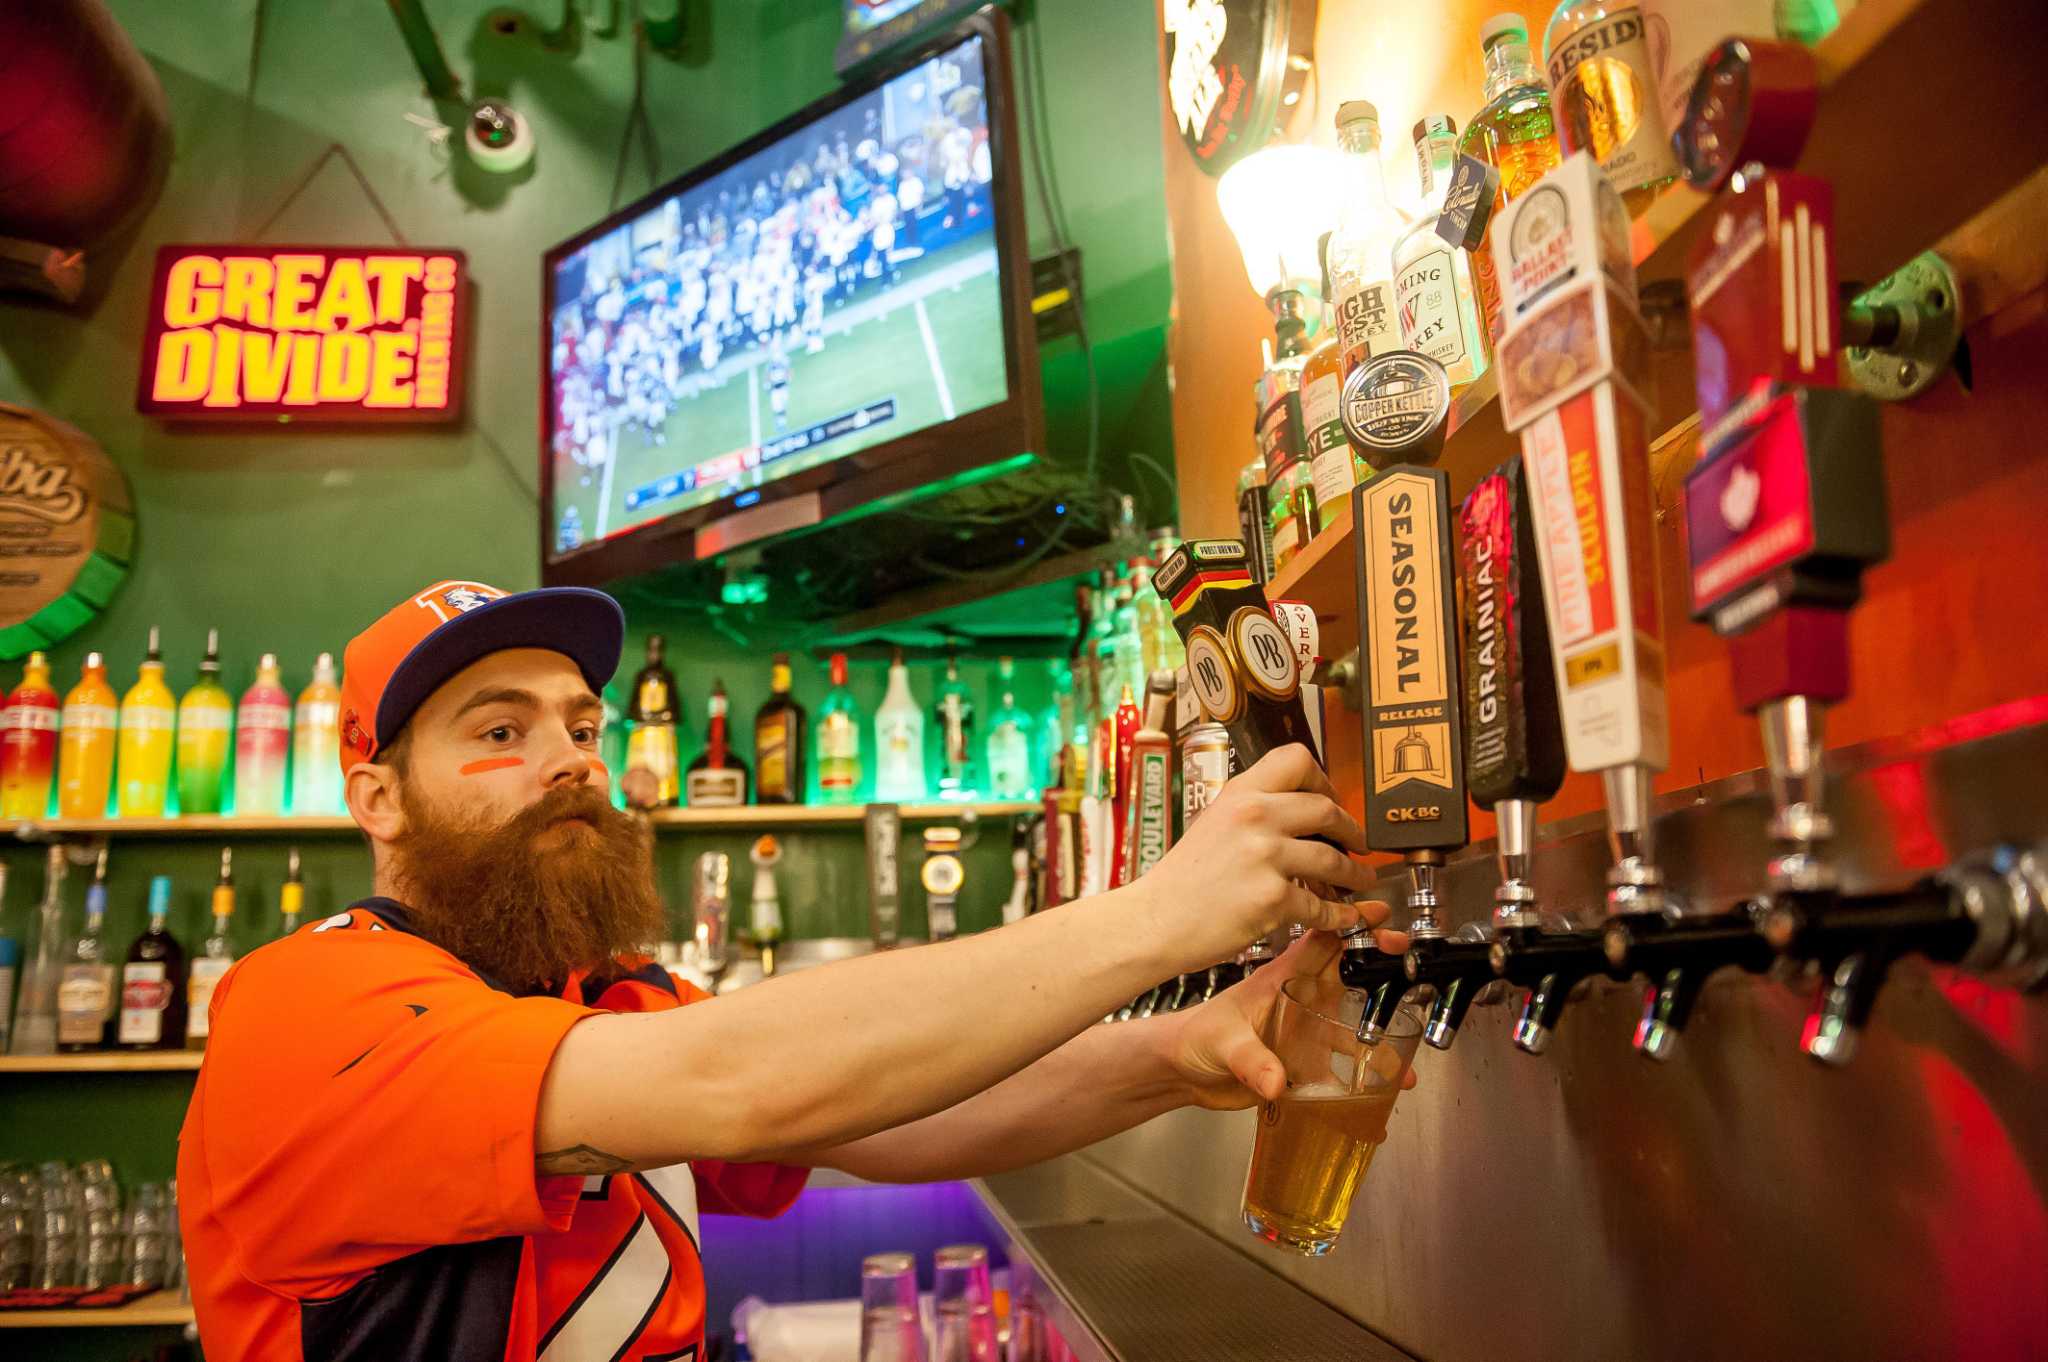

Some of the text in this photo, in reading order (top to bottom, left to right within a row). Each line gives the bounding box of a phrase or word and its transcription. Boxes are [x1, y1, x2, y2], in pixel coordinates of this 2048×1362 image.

[163, 254, 425, 333] GREAT
[152, 323, 419, 408] DIVIDE
[1354, 397, 1396, 424] COPPER
[1388, 492, 1421, 693] SEASONAL
[1476, 535, 1497, 724] GRAINIAC
[1252, 634, 1285, 670] PB
[1379, 706, 1443, 722] RELEASE
